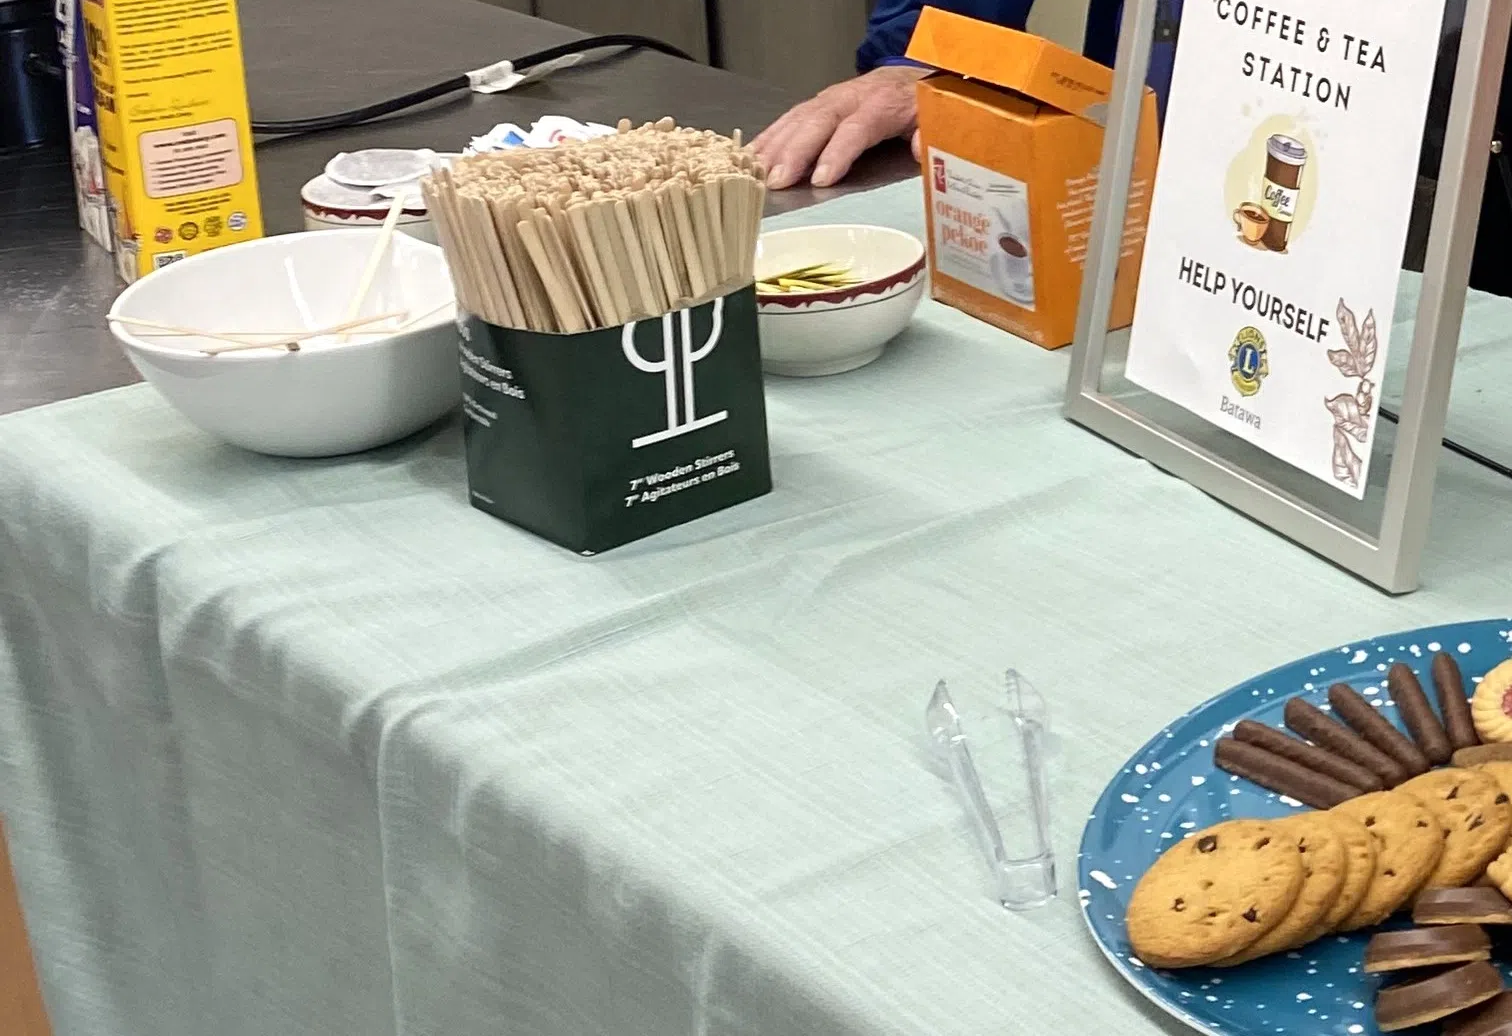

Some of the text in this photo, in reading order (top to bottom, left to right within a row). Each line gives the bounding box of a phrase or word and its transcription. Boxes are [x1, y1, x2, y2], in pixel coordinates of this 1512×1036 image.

[1317, 27, 1330, 53] &
[1343, 34, 1386, 73] TEA
[1242, 51, 1352, 111] STATION
[1264, 185, 1291, 207] Coffee
[936, 200, 990, 235] orange
[1178, 256, 1330, 344] HELP YOURSELF
[1242, 347, 1255, 375] L
[1220, 395, 1261, 430] Batawa
[641, 476, 701, 502] Agitateurs
[701, 471, 716, 482] en
[717, 461, 740, 477] Bois
[645, 464, 694, 485] Wooden
[694, 449, 736, 470] Stirrers
